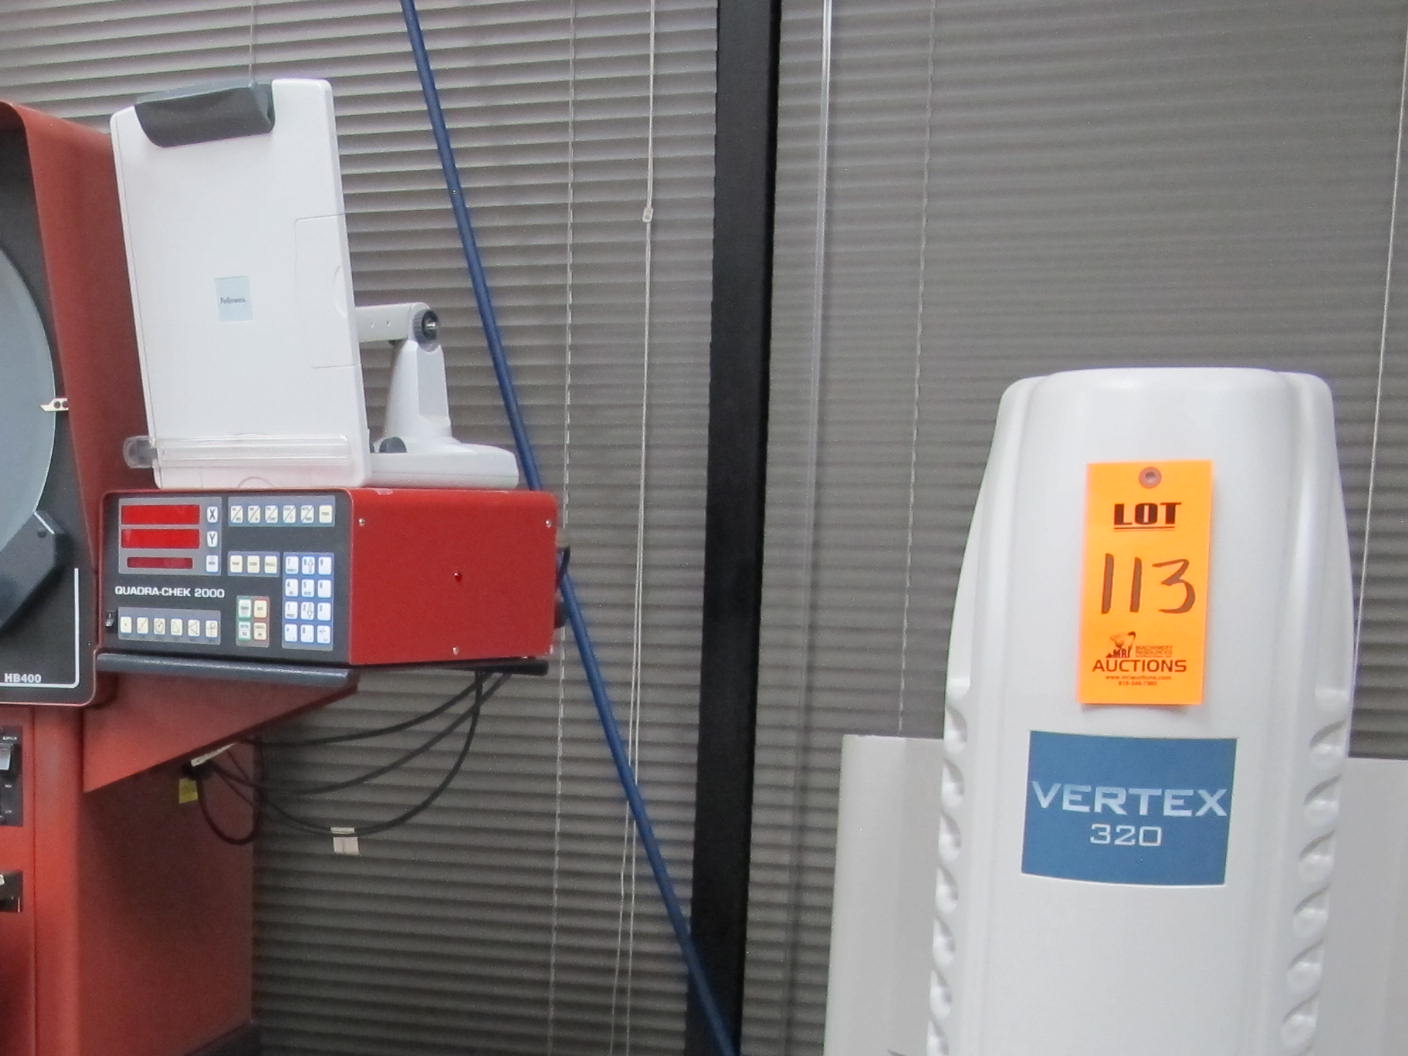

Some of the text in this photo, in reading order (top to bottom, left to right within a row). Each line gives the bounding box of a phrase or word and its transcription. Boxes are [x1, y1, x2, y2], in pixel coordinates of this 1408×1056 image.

[1113, 502, 1182, 526] LOT
[114, 586, 225, 598] QUADRA-CHEK 2000
[1100, 552, 1196, 615] 113
[4, 672, 42, 684] HB400
[1092, 659, 1188, 673] AUCTIONS
[1031, 780, 1228, 817] VERTEX
[1090, 823, 1163, 847] 320
